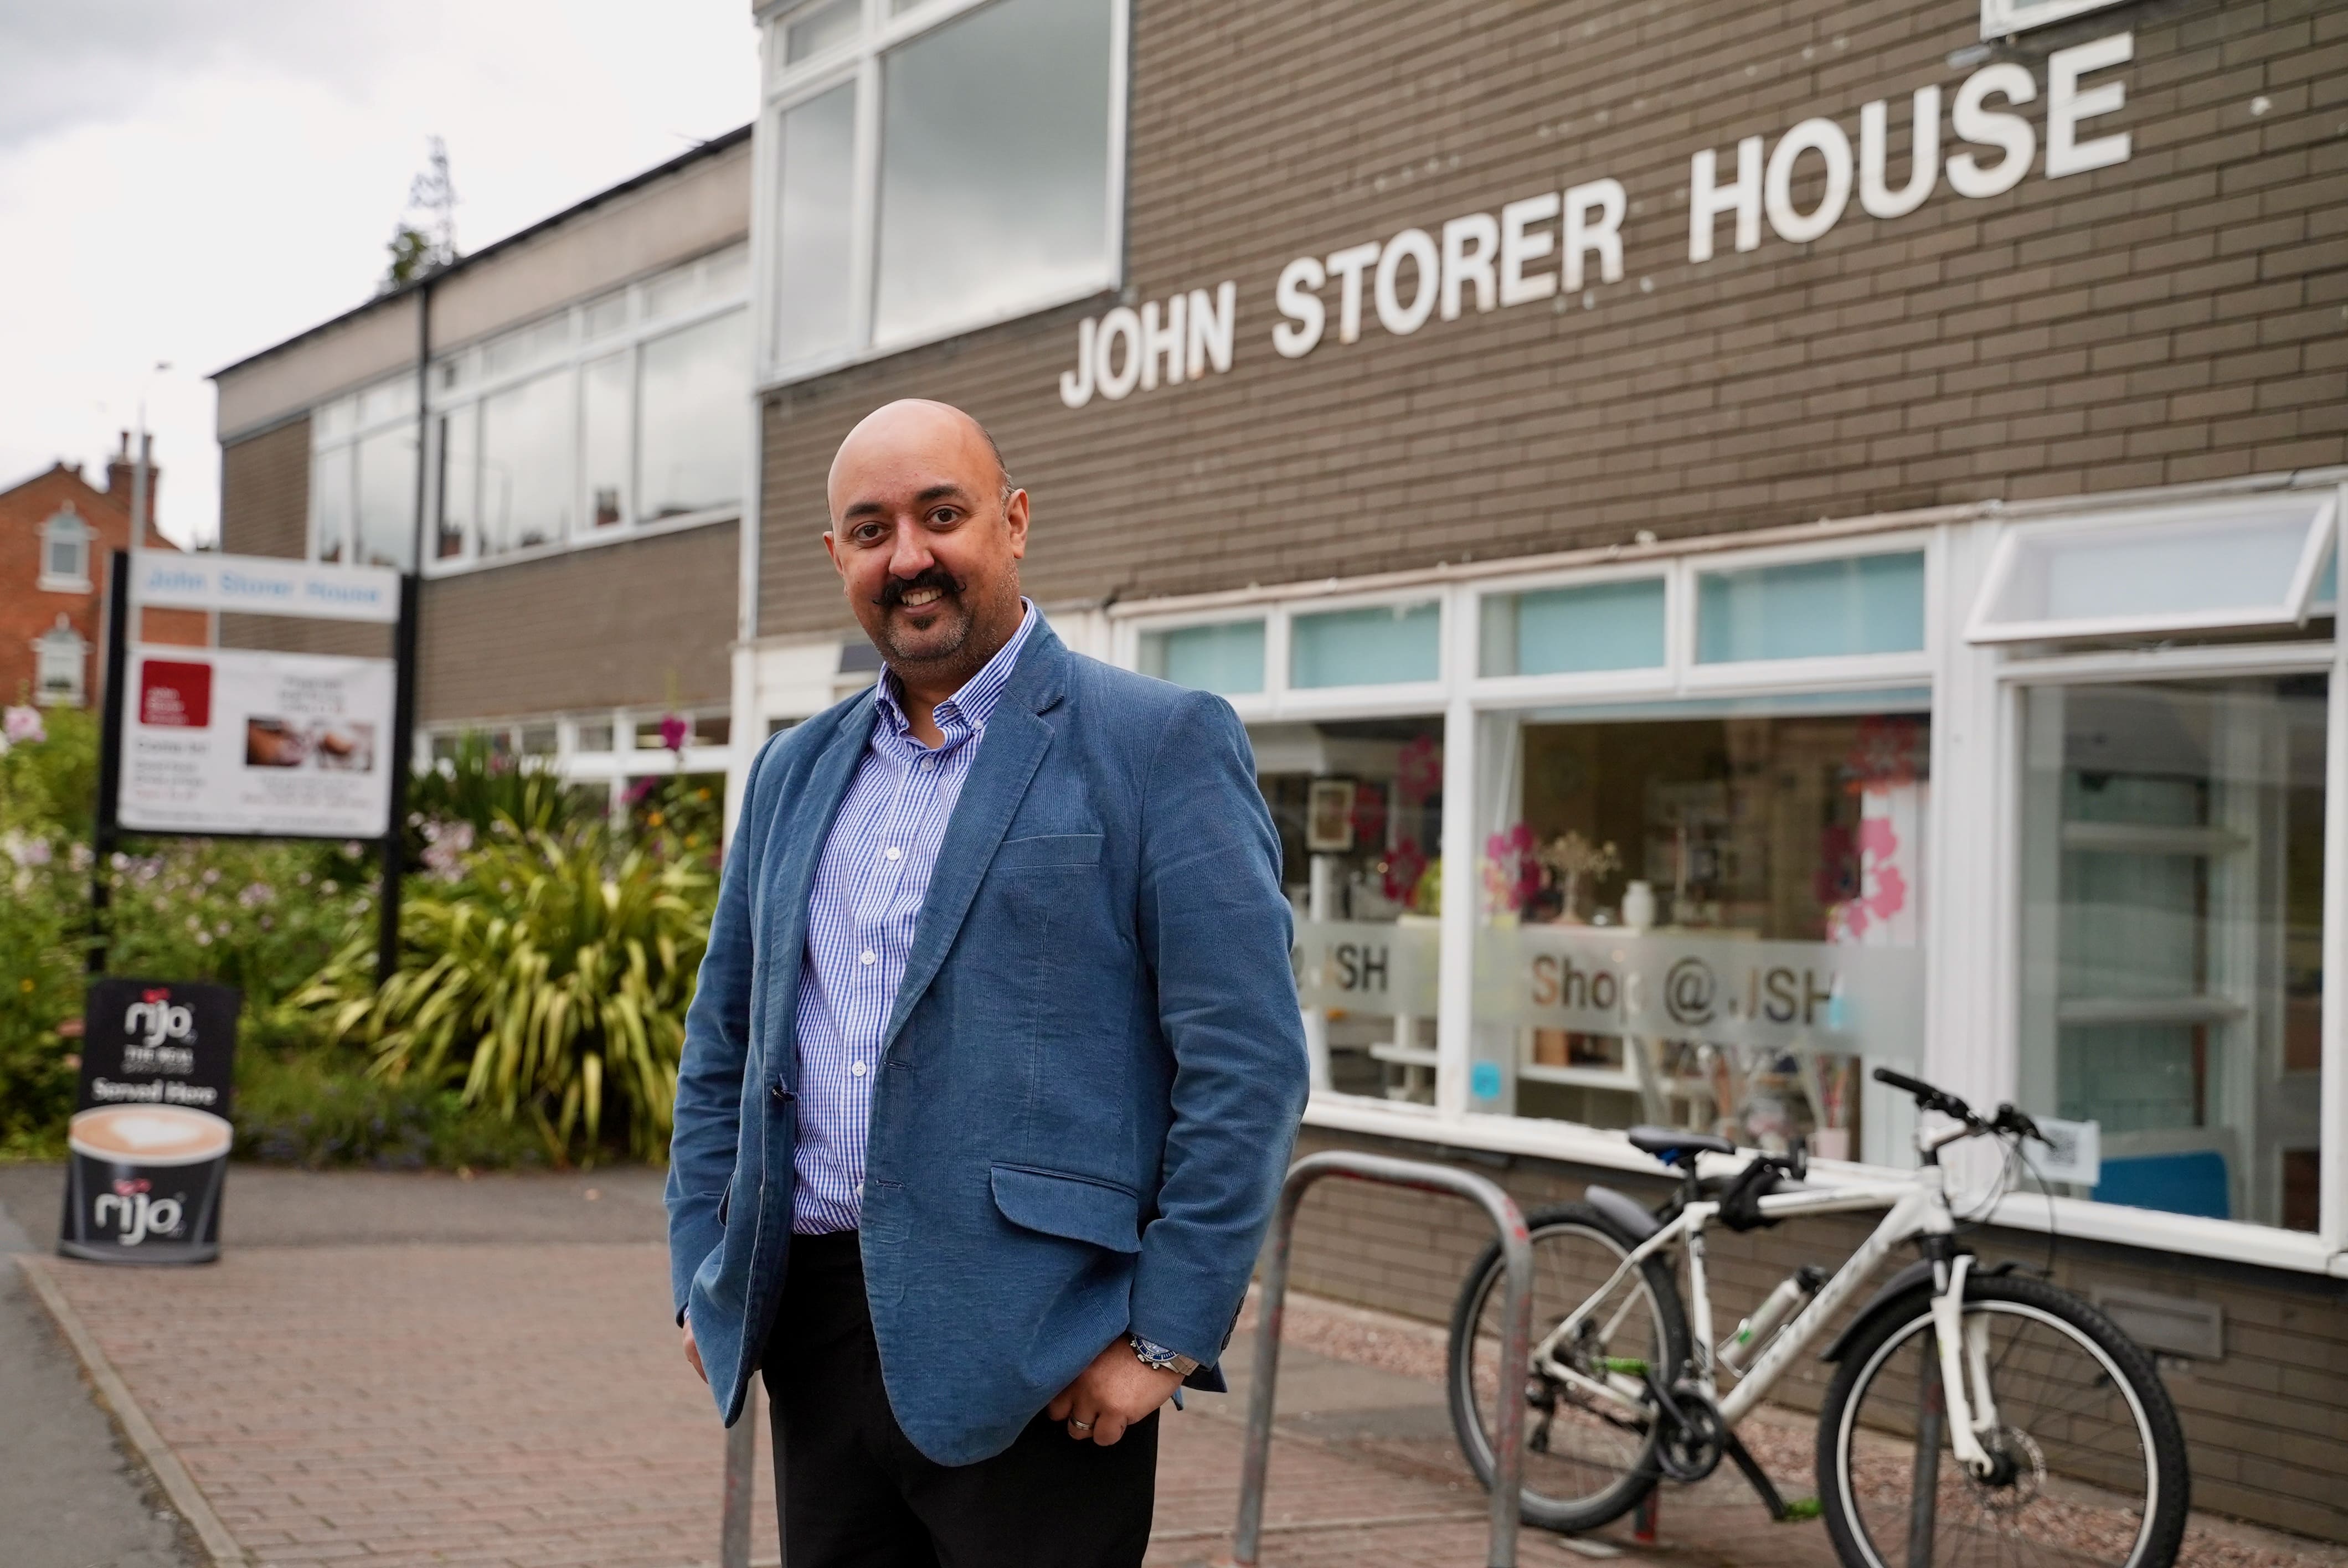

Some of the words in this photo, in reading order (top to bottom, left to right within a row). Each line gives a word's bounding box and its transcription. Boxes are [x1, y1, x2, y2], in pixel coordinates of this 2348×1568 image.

[1059, 280, 1236, 408] JOHN
[1272, 178, 1627, 359] STORER
[1688, 32, 2134, 264] HOUSE
[146, 567, 206, 591] John
[1663, 955, 1718, 1025] @
